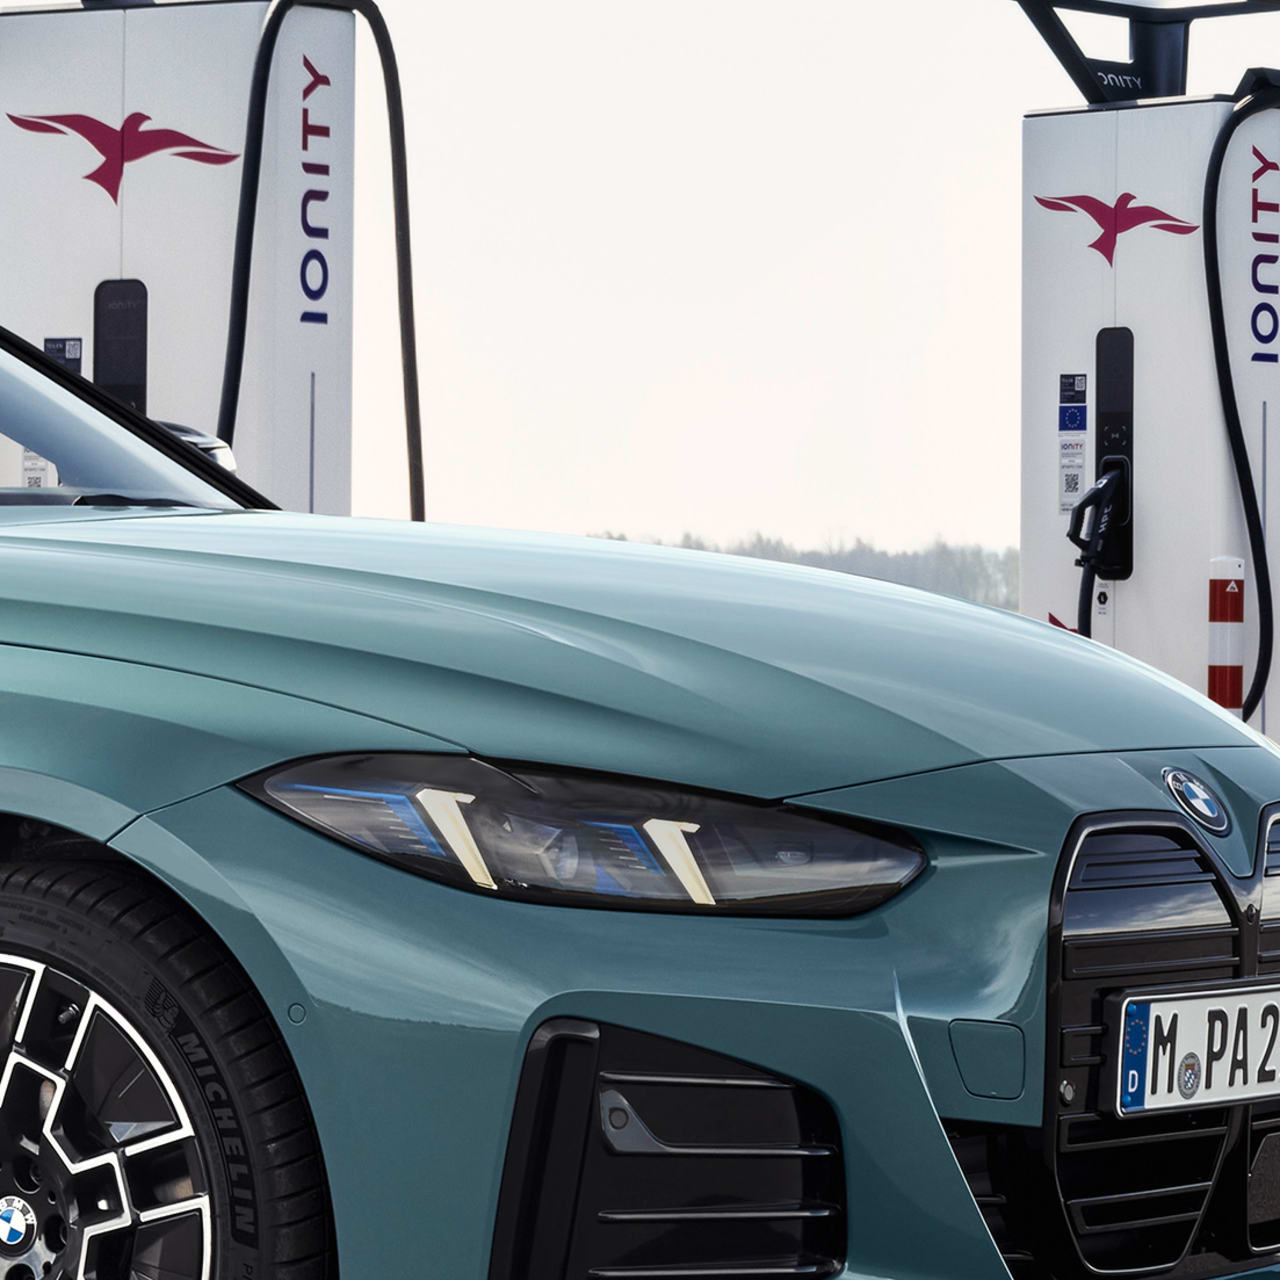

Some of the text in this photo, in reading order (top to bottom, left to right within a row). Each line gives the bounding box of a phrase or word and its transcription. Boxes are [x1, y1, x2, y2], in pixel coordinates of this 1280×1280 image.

[299, 53, 331, 325] IONITY
[1251, 144, 1280, 364] IONITY
[177, 1032, 255, 1235] MICHELIN
[1128, 1070, 1139, 1093] D
[1151, 1012, 1179, 1095] M
